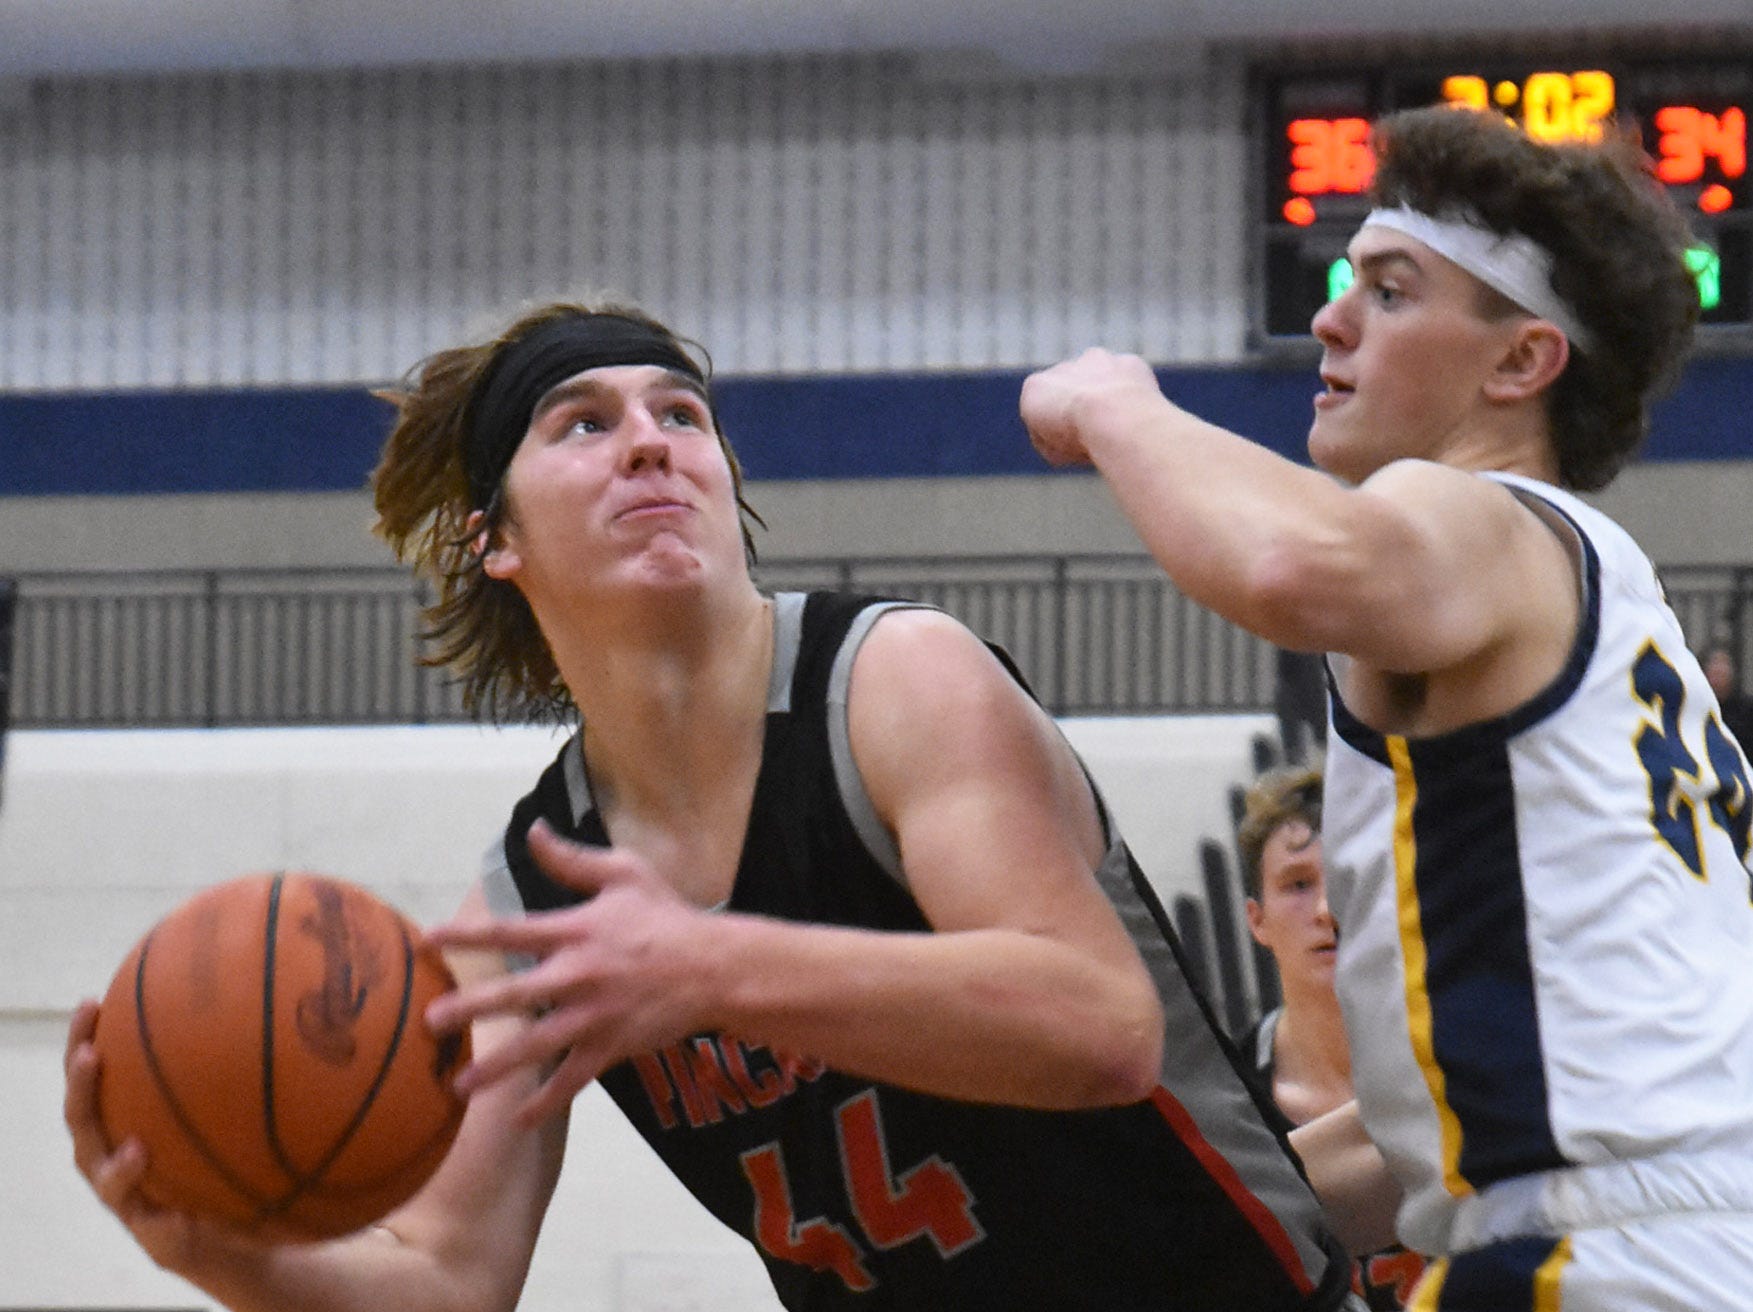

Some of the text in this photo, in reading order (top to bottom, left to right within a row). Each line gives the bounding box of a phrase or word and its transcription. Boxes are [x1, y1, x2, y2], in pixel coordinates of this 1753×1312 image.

[1286, 117, 1377, 195] 36
[1655, 106, 1747, 185] 34
[739, 1087, 989, 1293] 44
